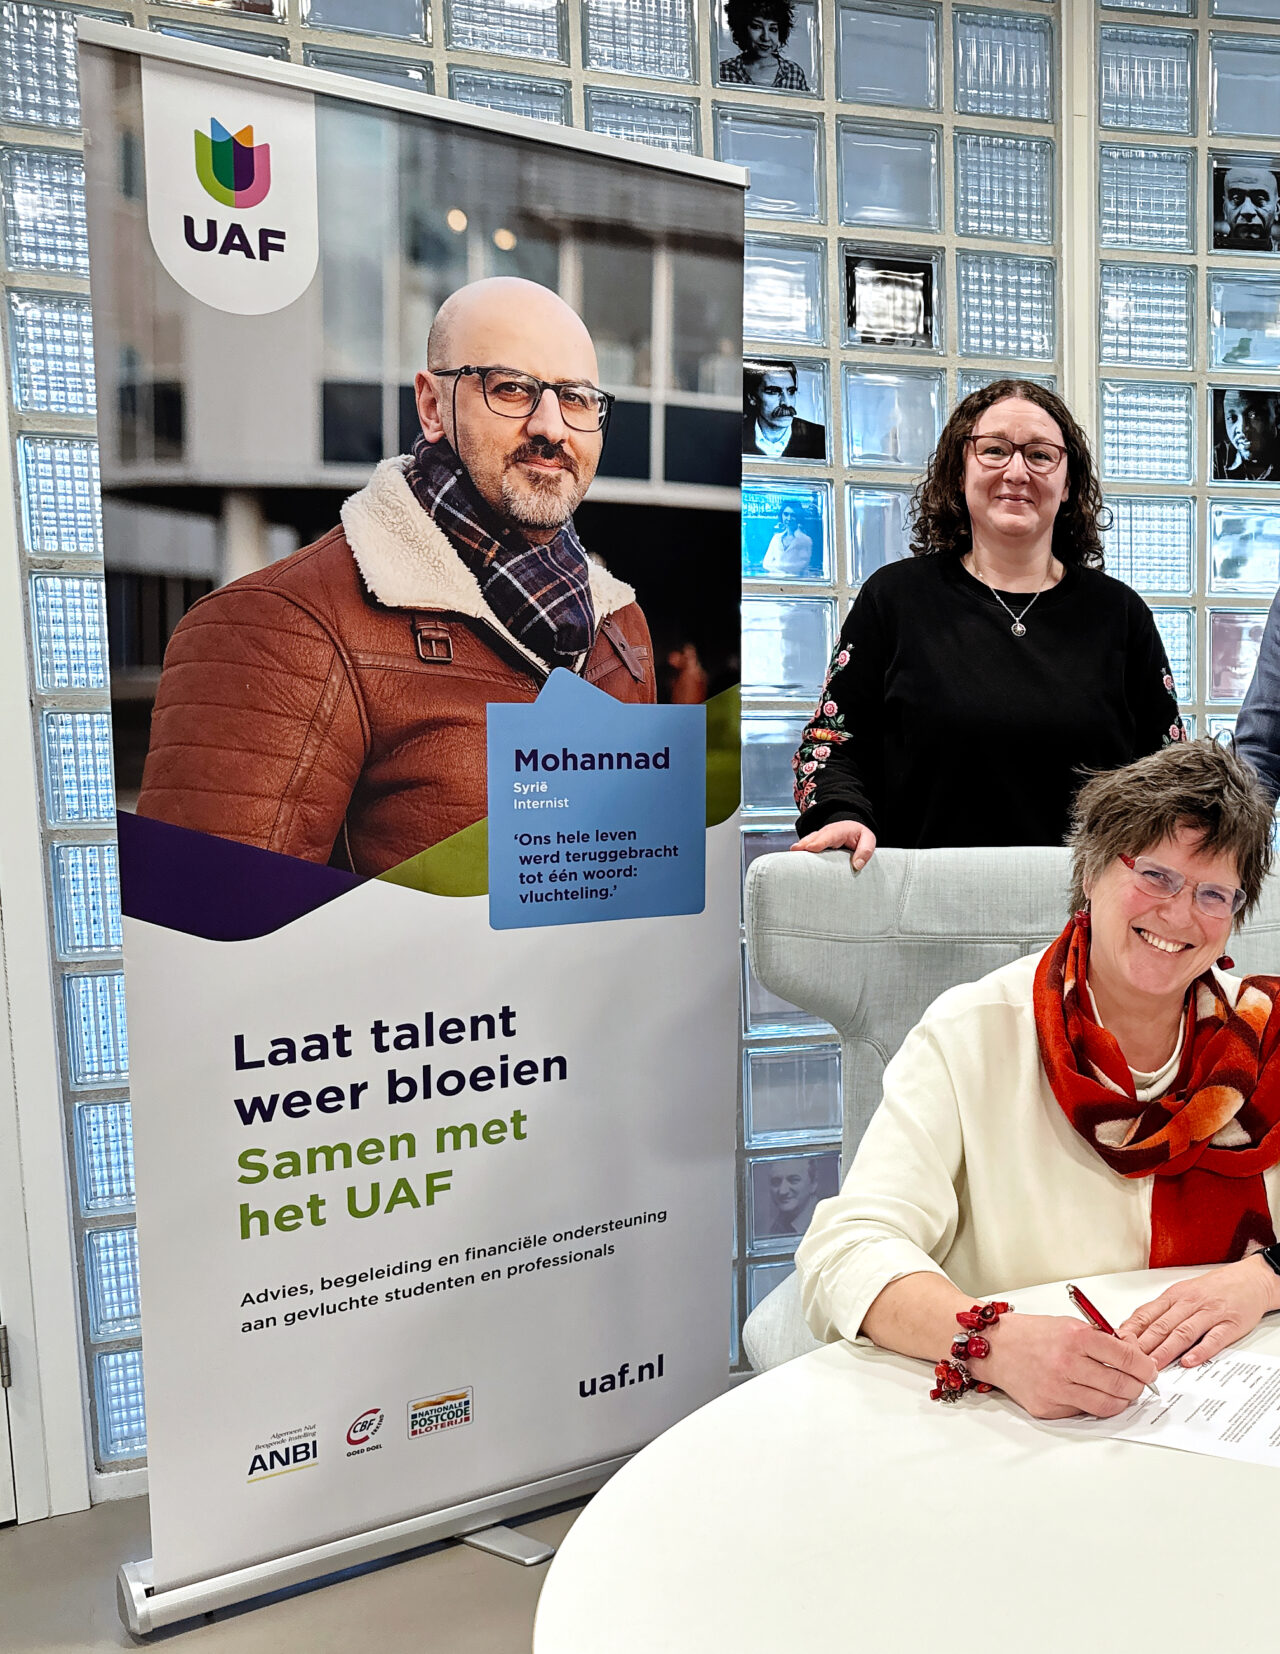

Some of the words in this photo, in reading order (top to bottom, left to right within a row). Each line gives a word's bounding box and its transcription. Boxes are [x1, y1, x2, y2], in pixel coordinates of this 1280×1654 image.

[183, 214, 286, 262] UAF
[514, 747, 670, 772] Mohannad
[513, 781, 548, 796] Syrië
[513, 797, 569, 810] Internist
[556, 831, 590, 844] hele
[595, 829, 637, 842] leven
[519, 851, 560, 865] werd
[565, 845, 679, 863] teruggebracht
[519, 872, 543, 885] tot
[548, 869, 578, 883] één
[583, 865, 638, 881] woord:
[234, 1024, 352, 1071] Laat
[370, 1005, 516, 1053] talent
[233, 1080, 369, 1126] weer
[387, 1054, 568, 1105] bloeien
[237, 1130, 416, 1185] Samen
[436, 1109, 528, 1153] met
[239, 1193, 327, 1240] het
[347, 1169, 453, 1219] UAF
[240, 1283, 314, 1307] Advies,
[320, 1258, 432, 1290] begeleiding
[438, 1253, 459, 1267] en
[465, 1234, 547, 1261] financiële
[552, 1210, 668, 1243] ondersteuning
[241, 1316, 277, 1333] aan
[284, 1294, 379, 1326] gevluchte
[385, 1274, 475, 1302] studenten
[480, 1267, 501, 1282] en
[507, 1243, 615, 1279] professionals
[579, 1353, 664, 1398] uaf.nl
[411, 1406, 470, 1430] POSTCODE
[418, 1402, 463, 1418] NATIONALE
[353, 1418, 376, 1433] CBF
[419, 1418, 463, 1434] LOTERIJ
[248, 1440, 317, 1476] ANBI
[346, 1449, 365, 1457] GOED
[366, 1444, 382, 1452] DOEL
